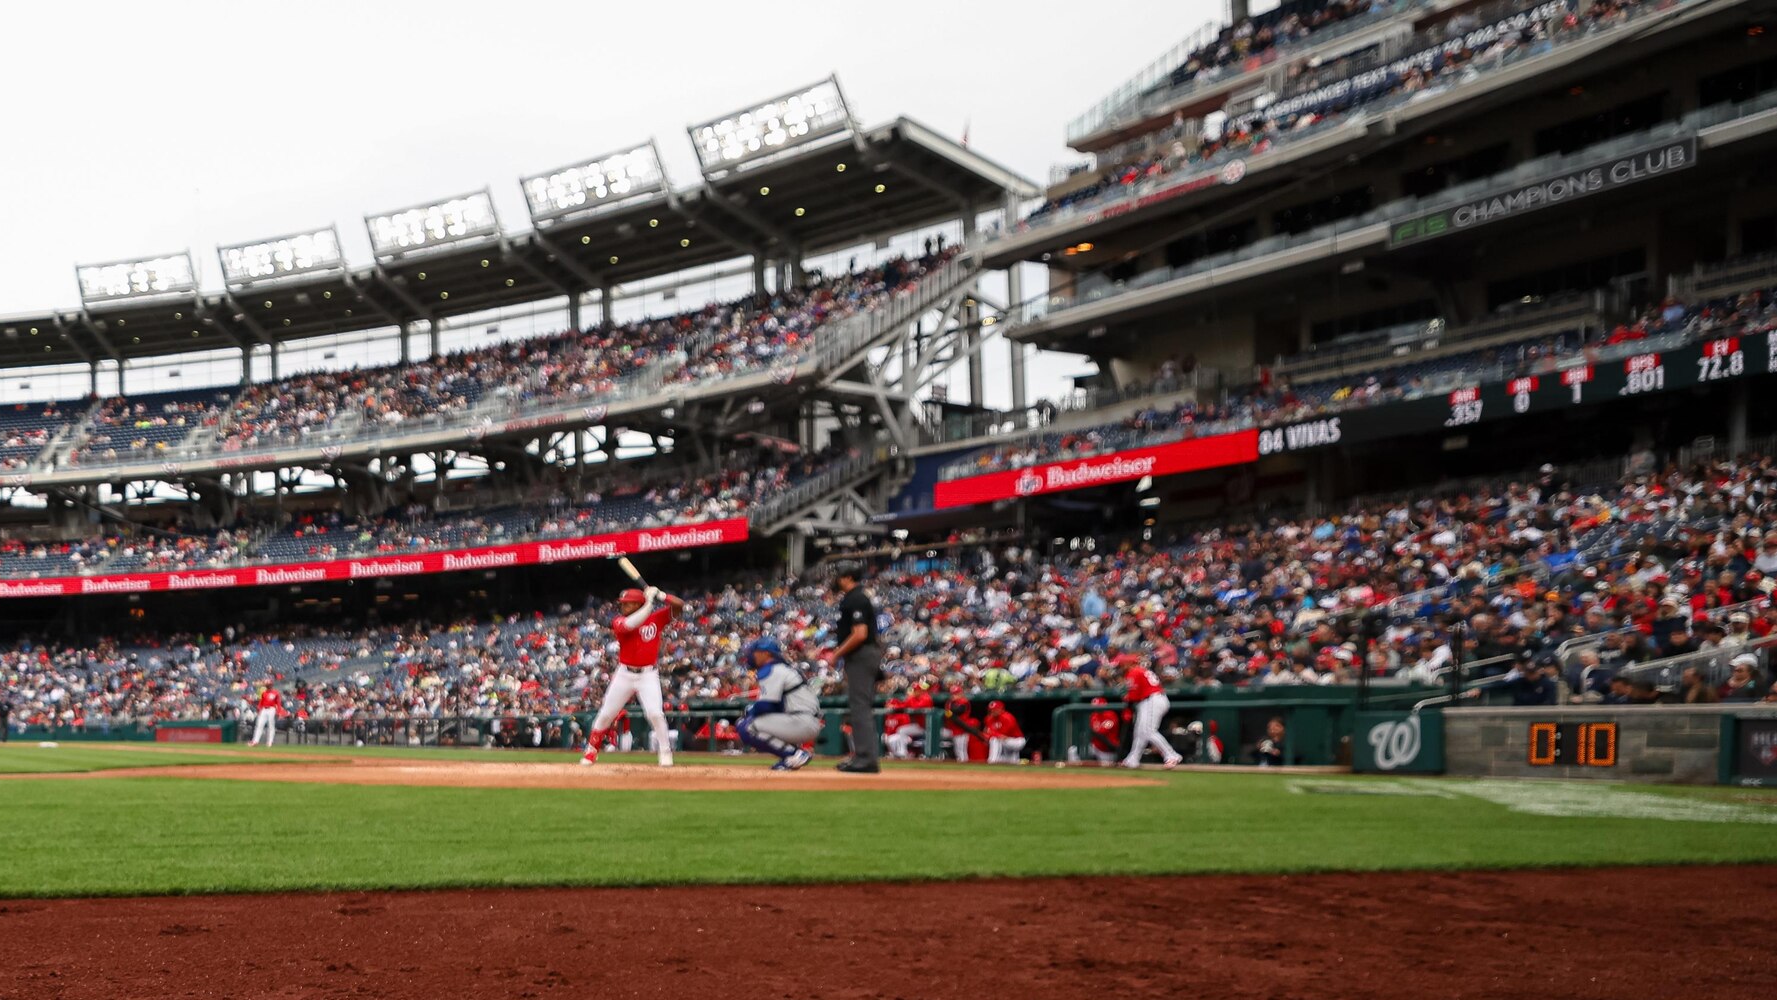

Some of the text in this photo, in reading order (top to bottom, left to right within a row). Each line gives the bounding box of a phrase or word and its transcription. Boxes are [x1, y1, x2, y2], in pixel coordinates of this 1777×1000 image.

[1452, 168, 1603, 228] CHAMPIONS
[1610, 145, 1686, 184] CLUB
[1285, 418, 1341, 450] VIVAS
[1696, 350, 1744, 382] 72.8
[1046, 455, 1156, 488] Budweiser
[638, 527, 723, 551] Budweiser
[443, 550, 517, 570] Budweiser
[538, 539, 617, 562] Budweiser
[255, 566, 327, 584] Budweiser
[350, 559, 424, 578] Budweiser
[82, 577, 151, 593] Budweiser
[169, 573, 237, 589] Budweiser
